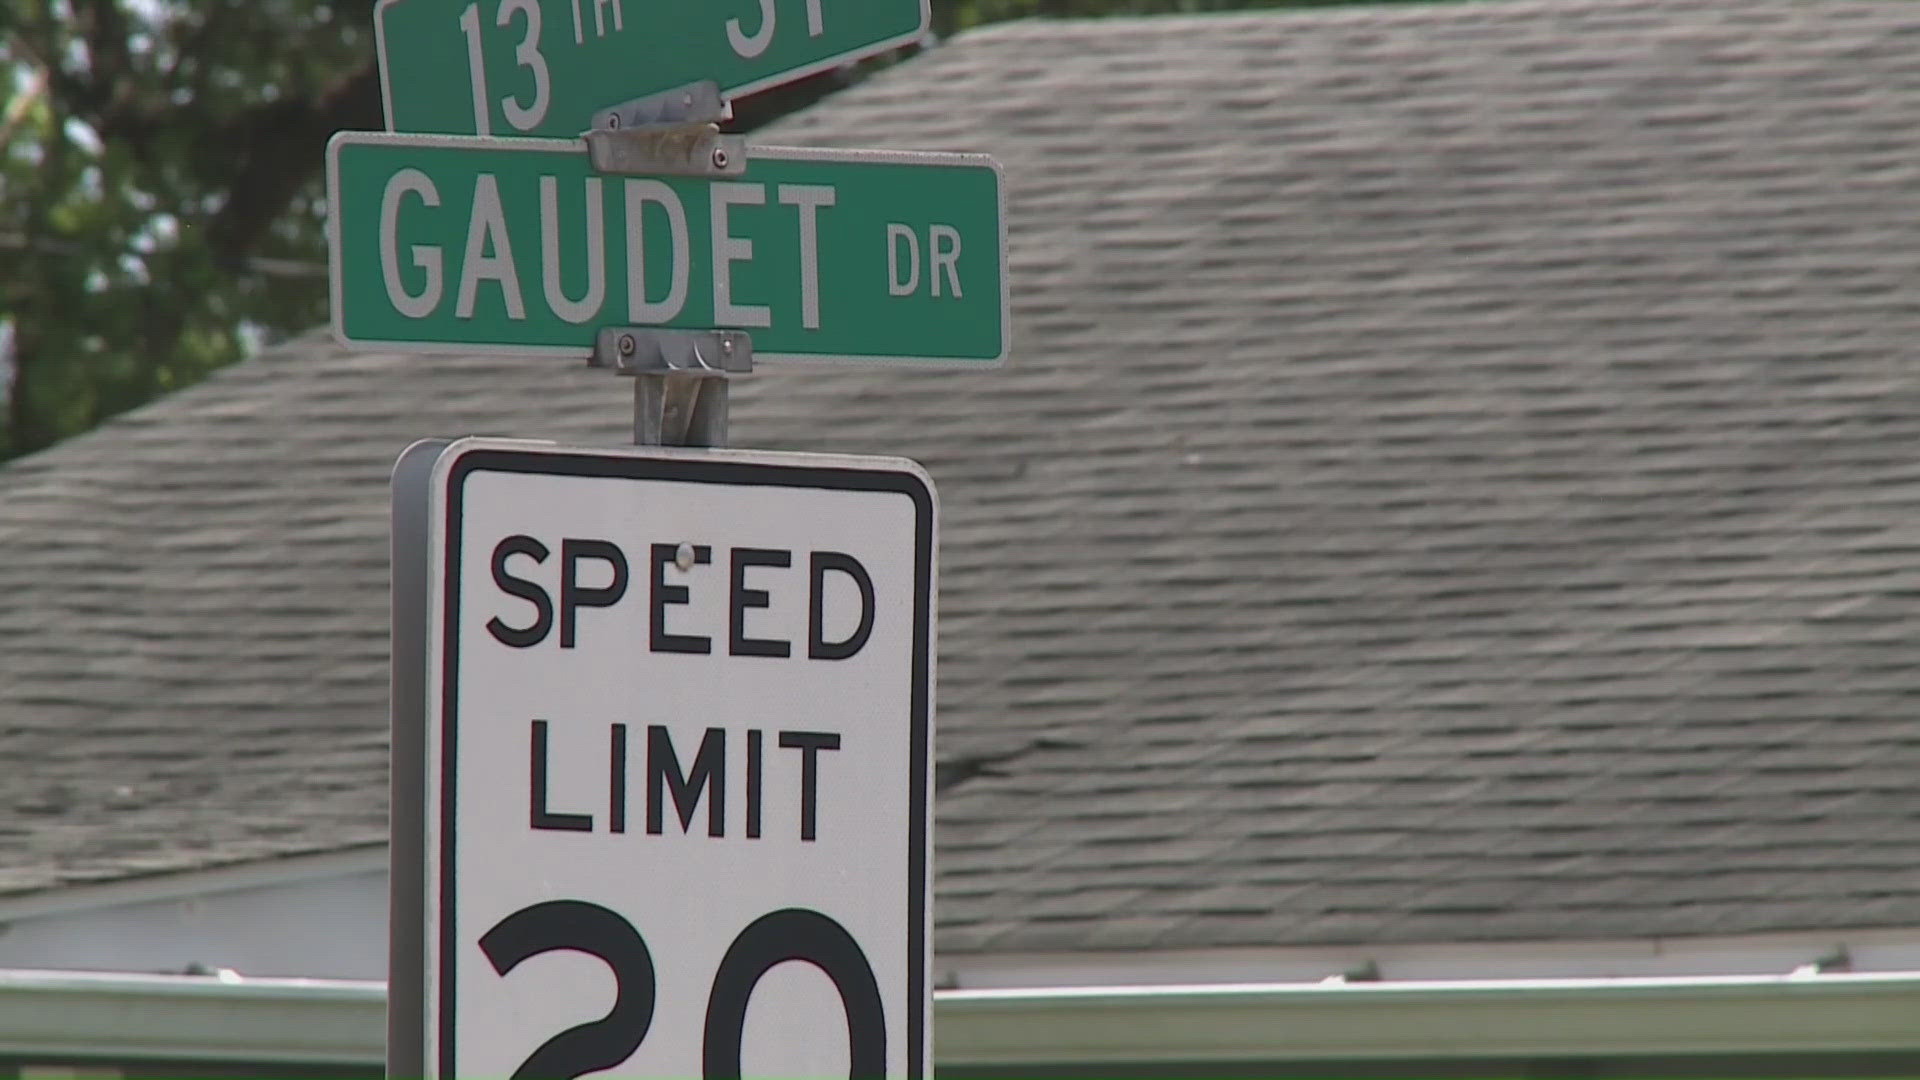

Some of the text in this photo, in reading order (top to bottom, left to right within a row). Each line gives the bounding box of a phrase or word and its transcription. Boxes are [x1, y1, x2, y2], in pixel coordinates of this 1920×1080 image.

[378, 168, 963, 330] GAUDET DR
[486, 535, 876, 661] SPEED
[530, 719, 841, 842] LIMIT
[478, 899, 887, 1080] 20
